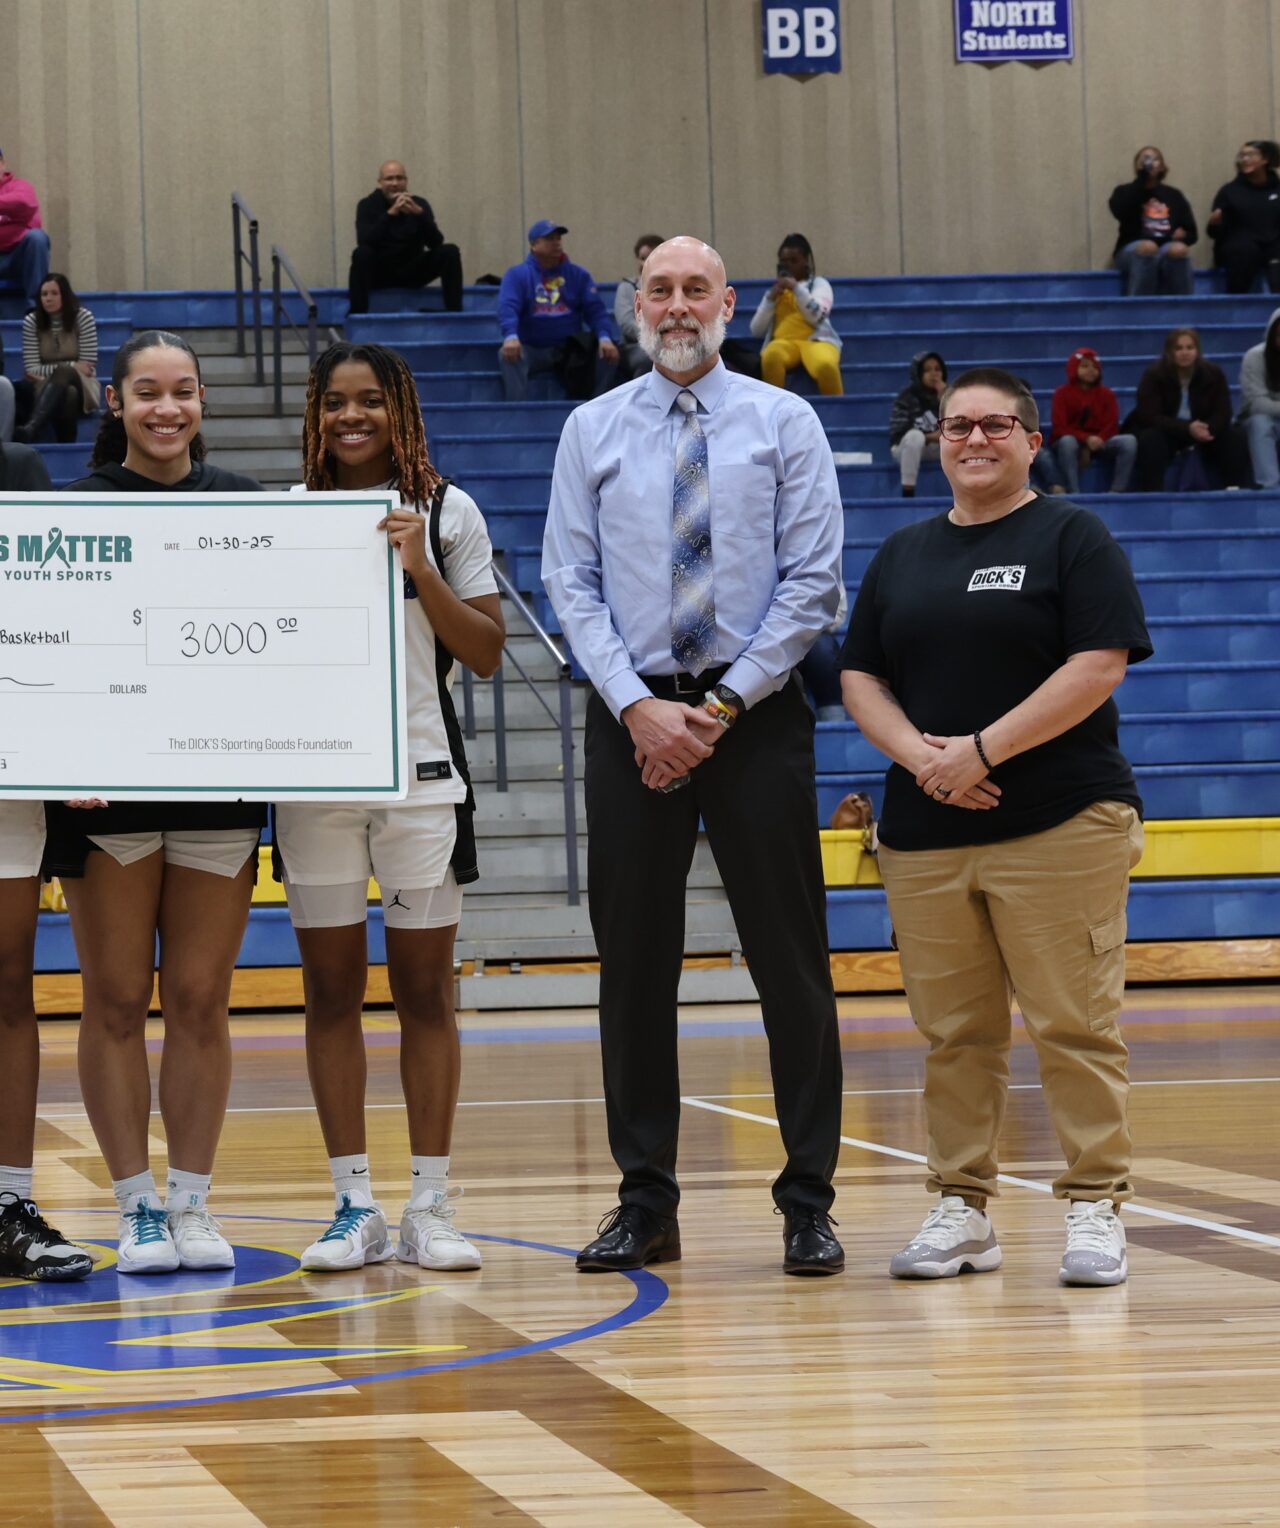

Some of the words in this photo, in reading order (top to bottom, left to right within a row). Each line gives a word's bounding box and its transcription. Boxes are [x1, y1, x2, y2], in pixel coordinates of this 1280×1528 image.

[971, 1, 1056, 28] NORTH
[767, 7, 837, 58] BB
[962, 30, 1067, 51] Students
[164, 543, 180, 551] DATE
[198, 535, 274, 550] 01-30-25
[4, 570, 51, 581] YOUTH
[56, 570, 112, 581] SPORTS
[972, 568, 1021, 585] DICK'S
[133, 608, 142, 626] $
[0, 629, 70, 644] Basketball
[180, 621, 267, 657] 3000
[109, 684, 147, 694] DOLLARS
[169, 738, 186, 750] The
[188, 738, 219, 750] DICK'S
[221, 738, 263, 751] Sporting
[265, 738, 296, 750] Goods
[297, 738, 352, 750] Foundation
